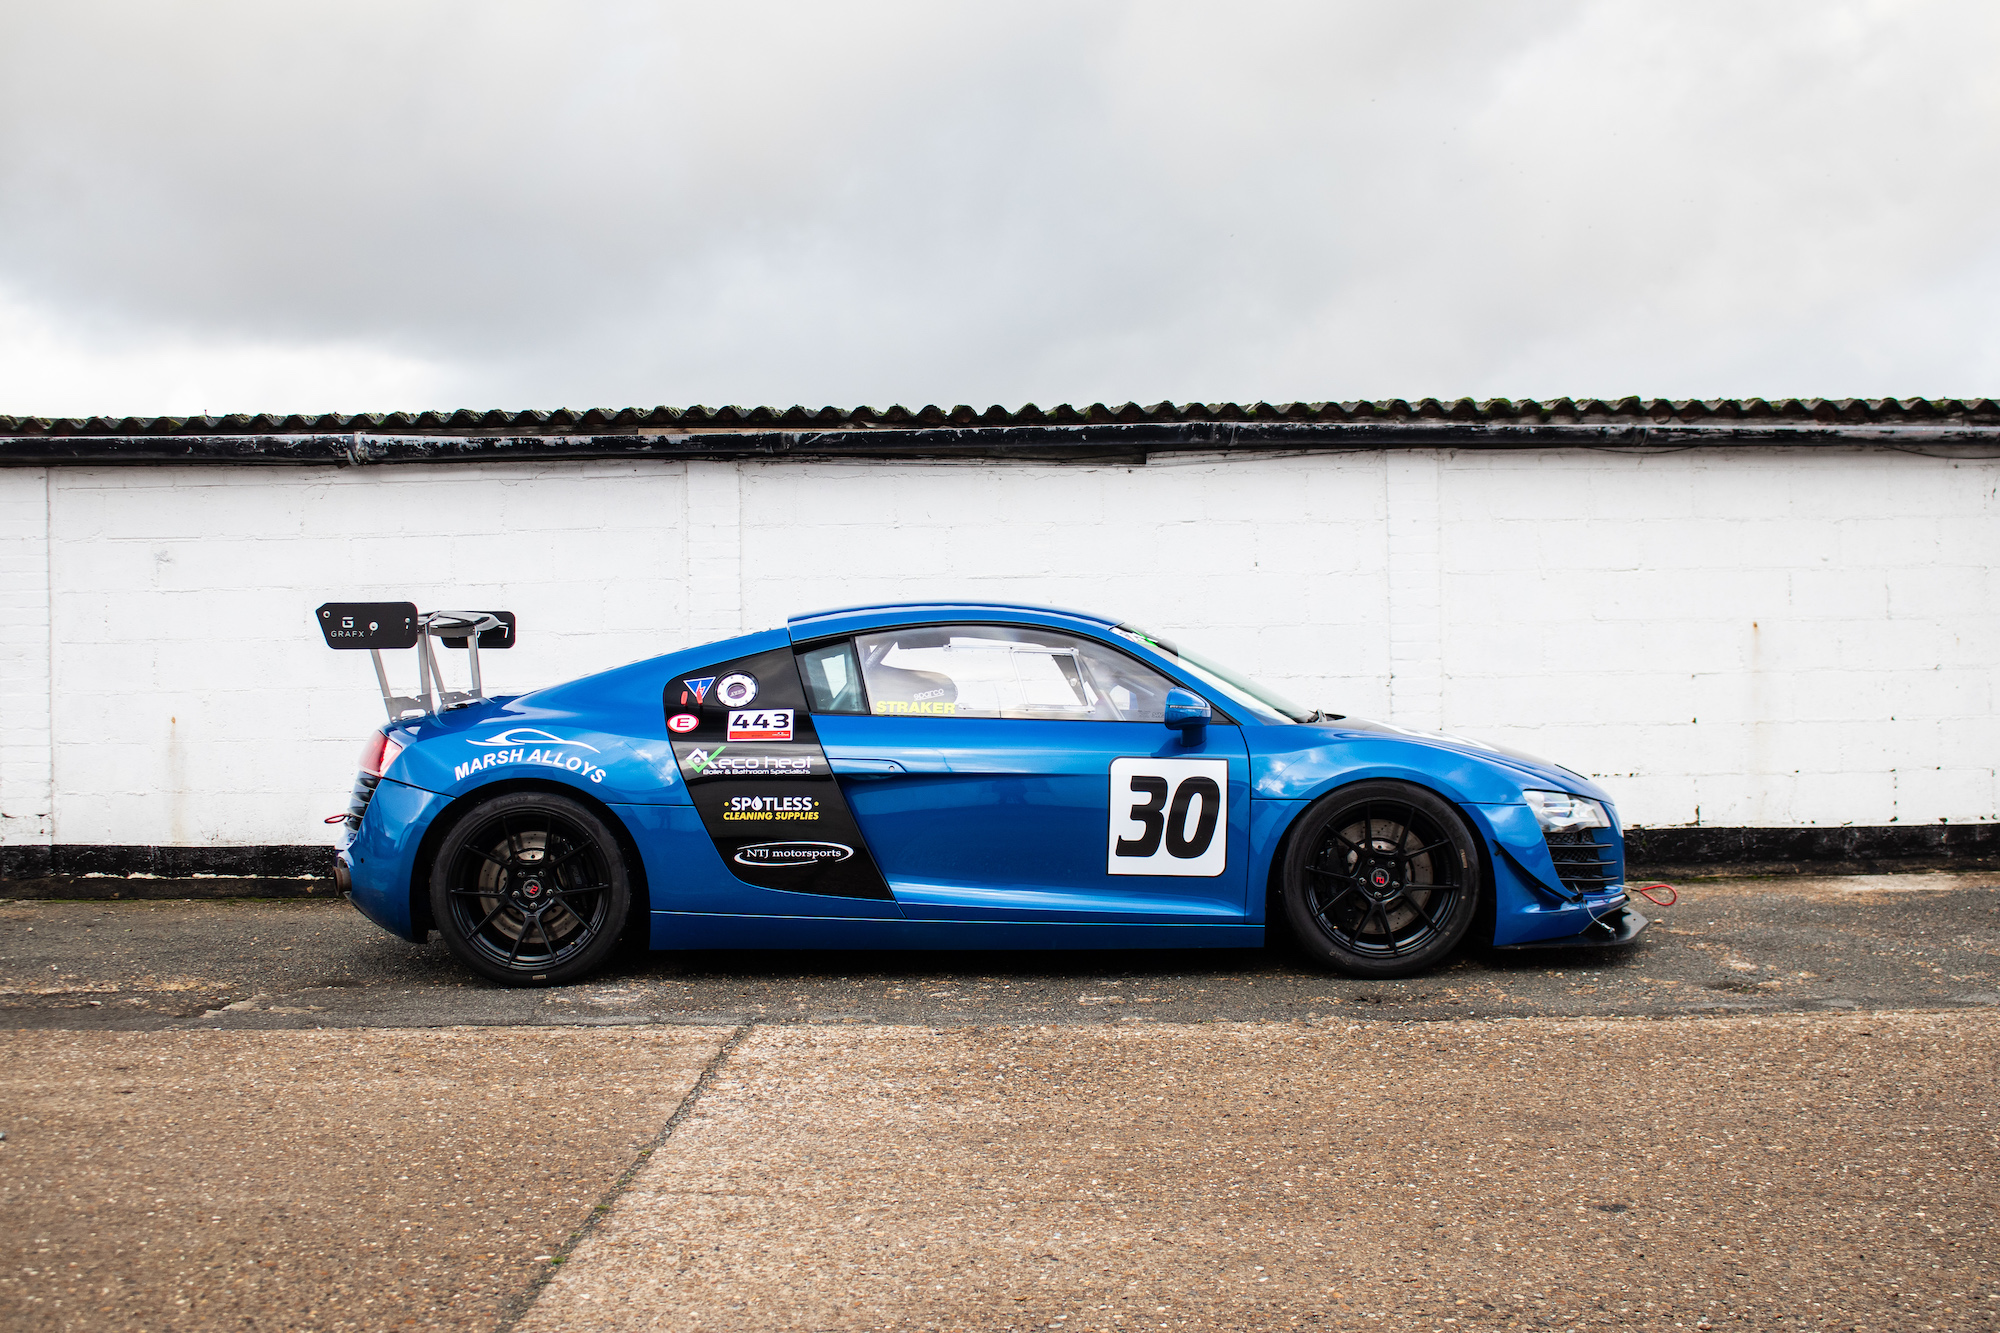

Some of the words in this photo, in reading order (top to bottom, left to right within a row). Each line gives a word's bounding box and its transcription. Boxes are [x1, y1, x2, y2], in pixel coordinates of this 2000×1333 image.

[876, 700, 956, 715] STRAKER
[676, 717, 690, 728] E
[732, 713, 790, 729] 443
[454, 748, 525, 781] MARSH
[527, 749, 606, 784] ALLOYS
[718, 758, 760, 769] eco
[764, 756, 814, 769] heat
[731, 796, 812, 811] SPOTLESS
[723, 812, 773, 820] CLEANING
[775, 812, 819, 820] SUPPLIES
[1115, 775, 1220, 859] 30
[746, 849, 769, 858] NTJ
[772, 849, 841, 859] motorsports
